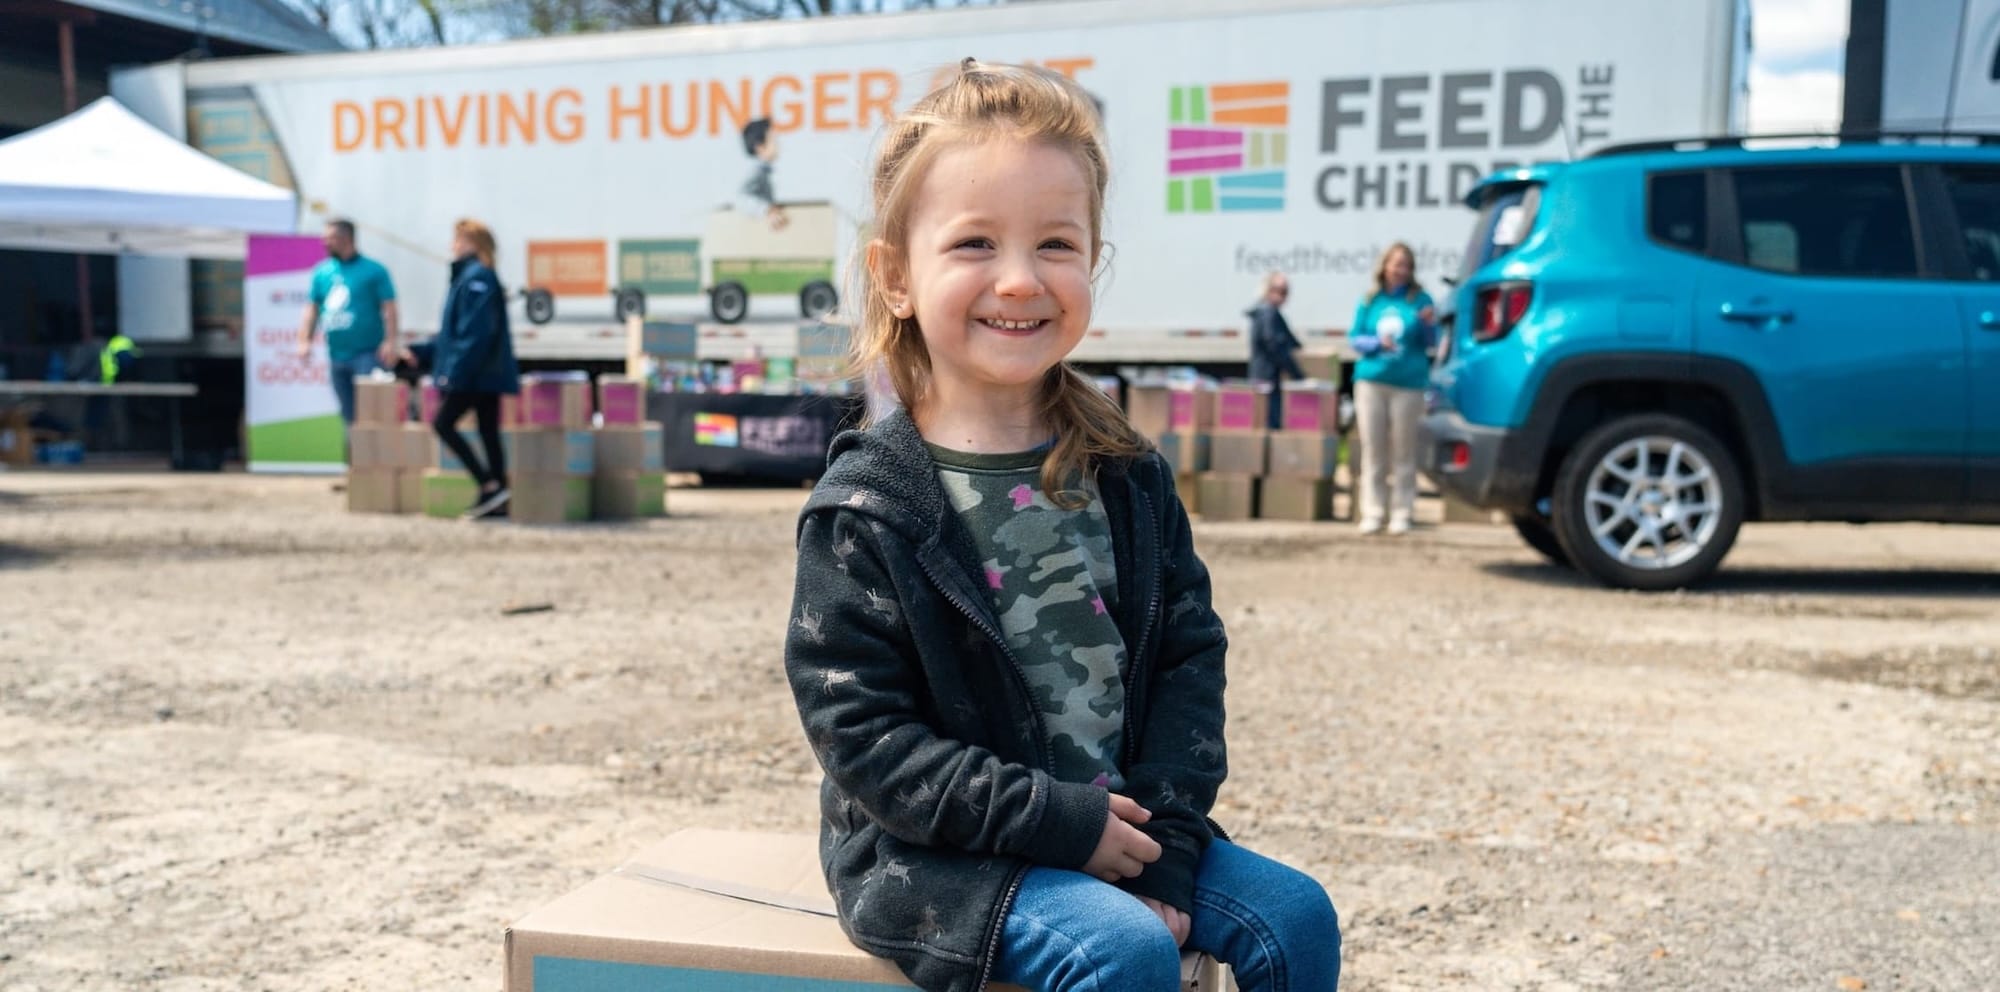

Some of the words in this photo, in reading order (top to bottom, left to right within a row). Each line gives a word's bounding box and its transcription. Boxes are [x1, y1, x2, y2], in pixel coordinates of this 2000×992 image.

[332, 88, 585, 153] DRIVING
[608, 69, 901, 141] HUNGER
[1318, 69, 1565, 154] FEED
[1578, 65, 1614, 145] THE
